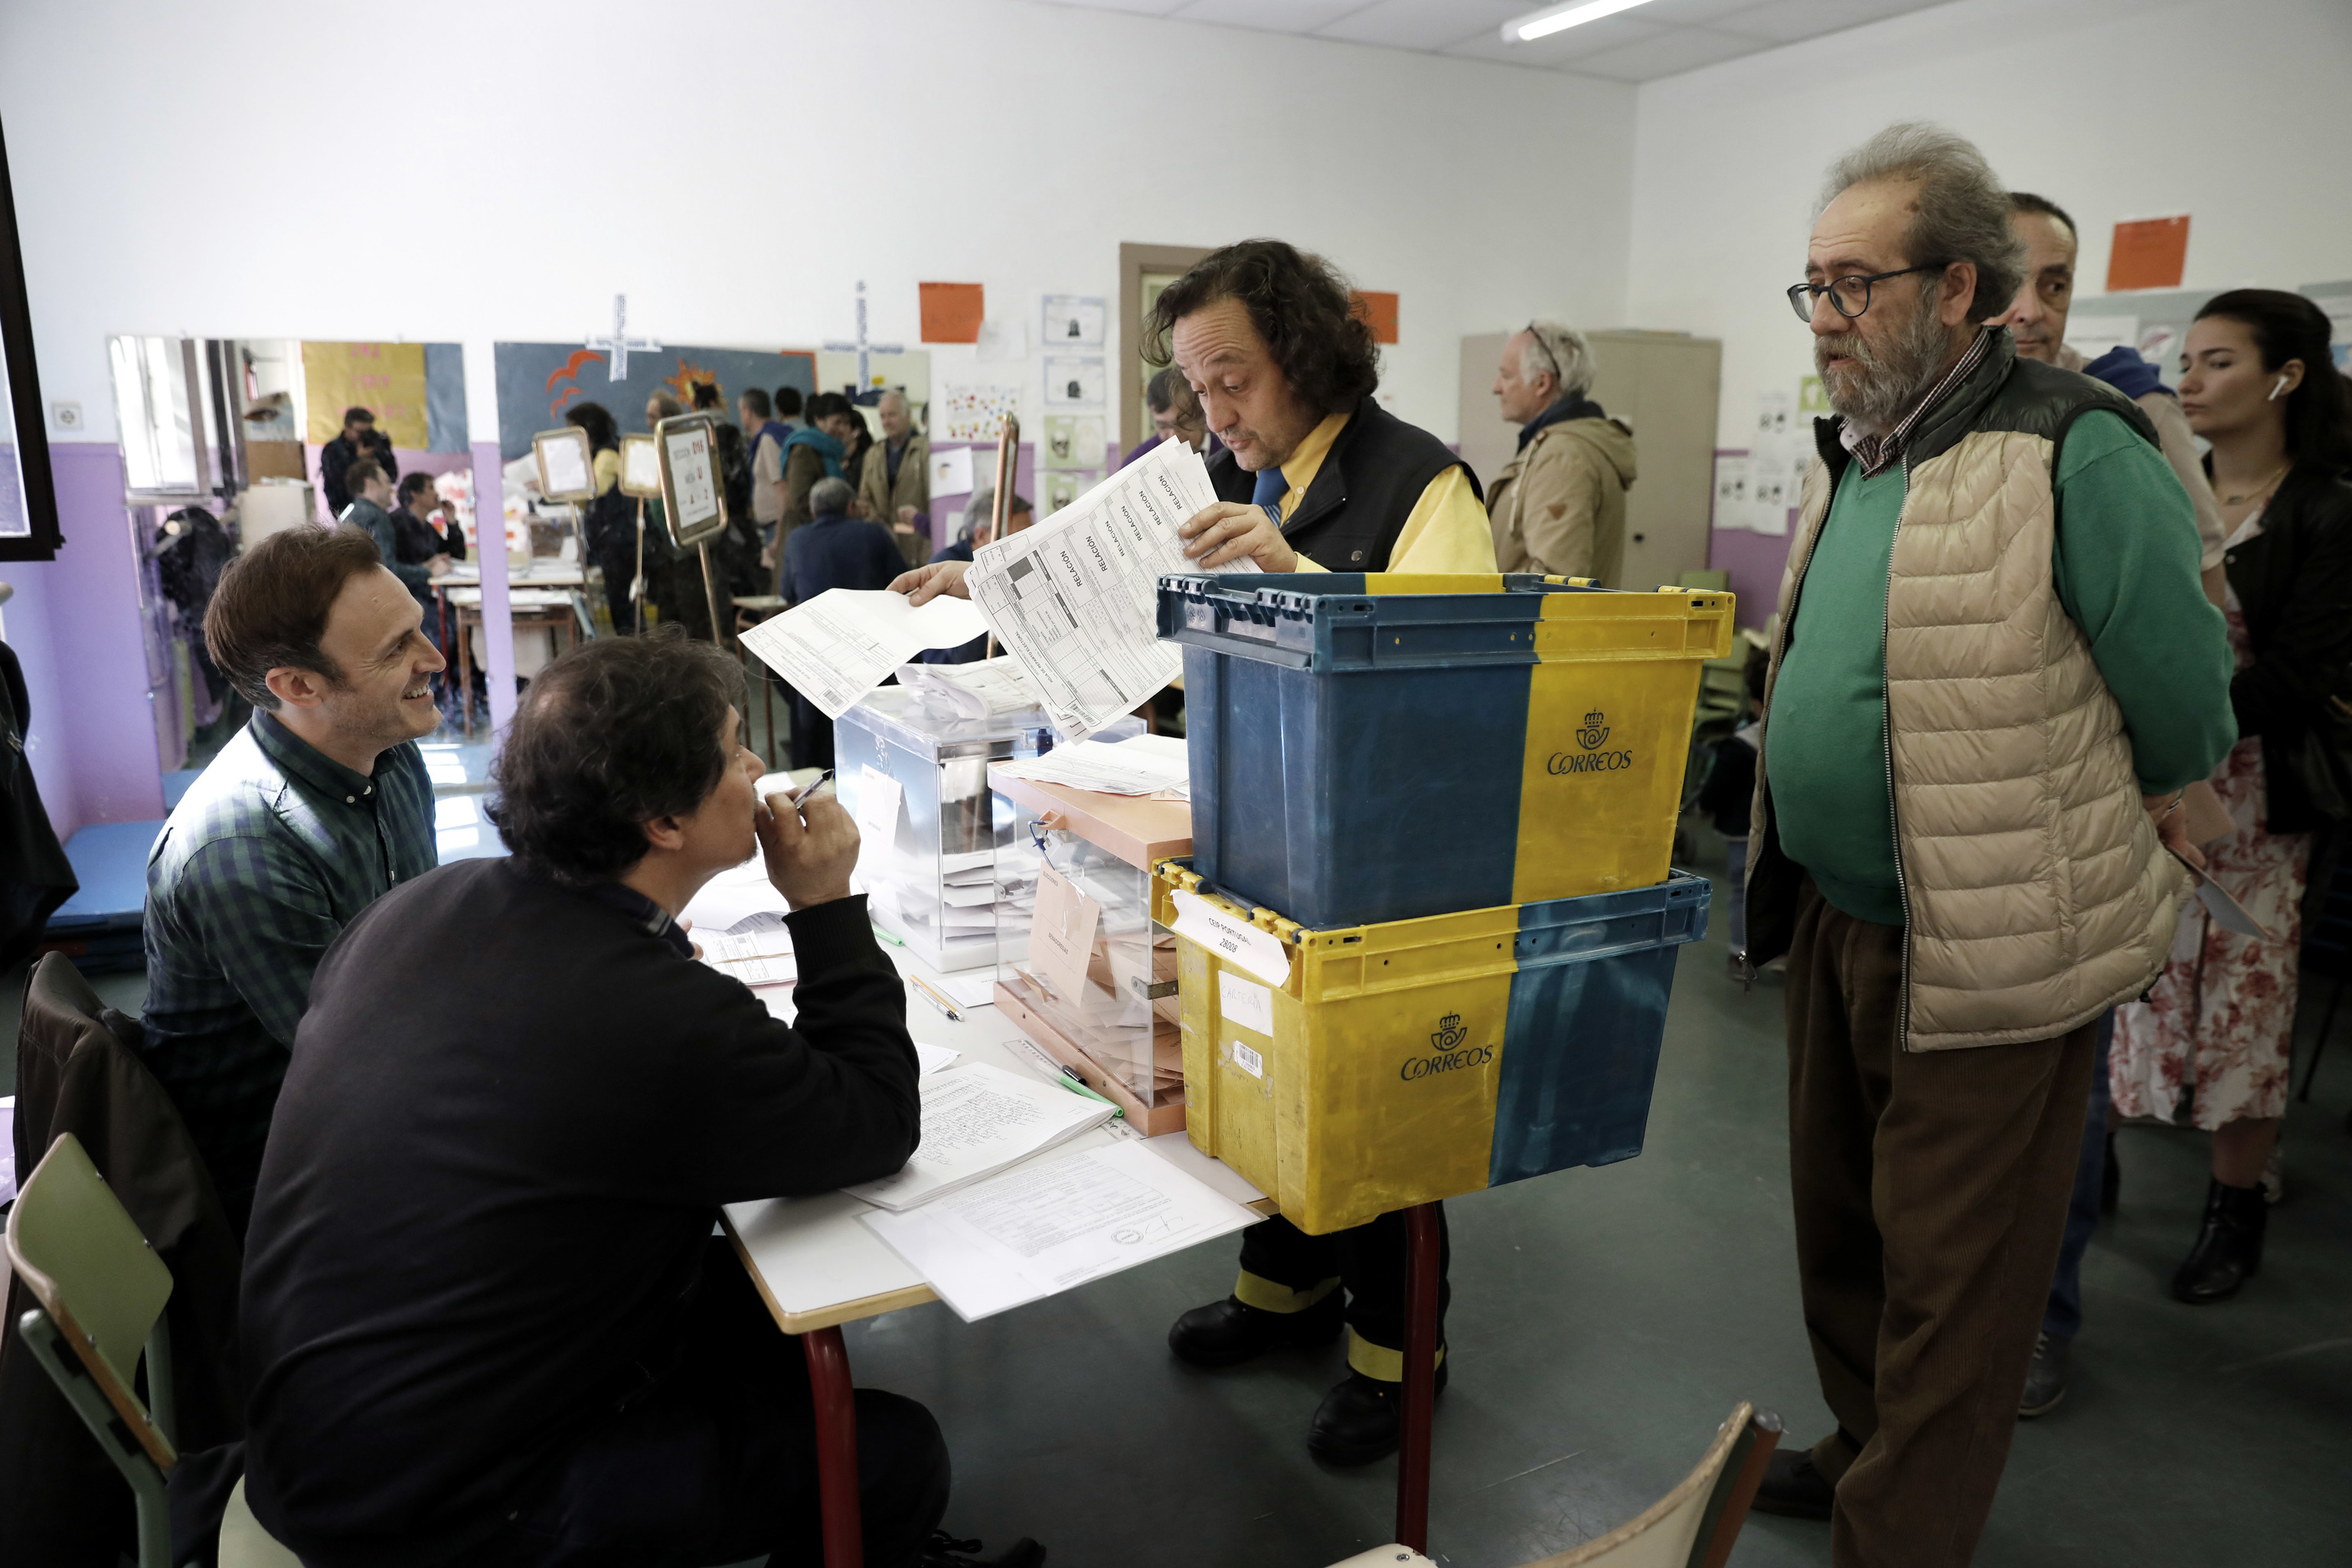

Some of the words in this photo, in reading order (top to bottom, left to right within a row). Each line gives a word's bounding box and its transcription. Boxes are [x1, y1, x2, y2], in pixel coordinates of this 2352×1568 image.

[1137, 489, 1162, 526] RELACIÓN
[1156, 474, 1183, 511] RELACIÓN
[1103, 520, 1125, 557] RELACIÓN
[1119, 505, 1143, 541] RELACIÓN
[1058, 550, 1083, 587] RELACIÓN
[1084, 535, 1108, 572] RELACIÓN
[1014, 630, 1030, 652] ELECTORAL
[1027, 651, 1042, 668] REPARTO
[1044, 672, 1054, 683] HOJA
[1547, 750, 1633, 776] CORREOS
[1208, 917, 1220, 929] CEIP
[1220, 923, 1253, 946] PORTUGAL
[1219, 937, 1239, 954] 28008
[1400, 1044, 1494, 1081] CORREOS
